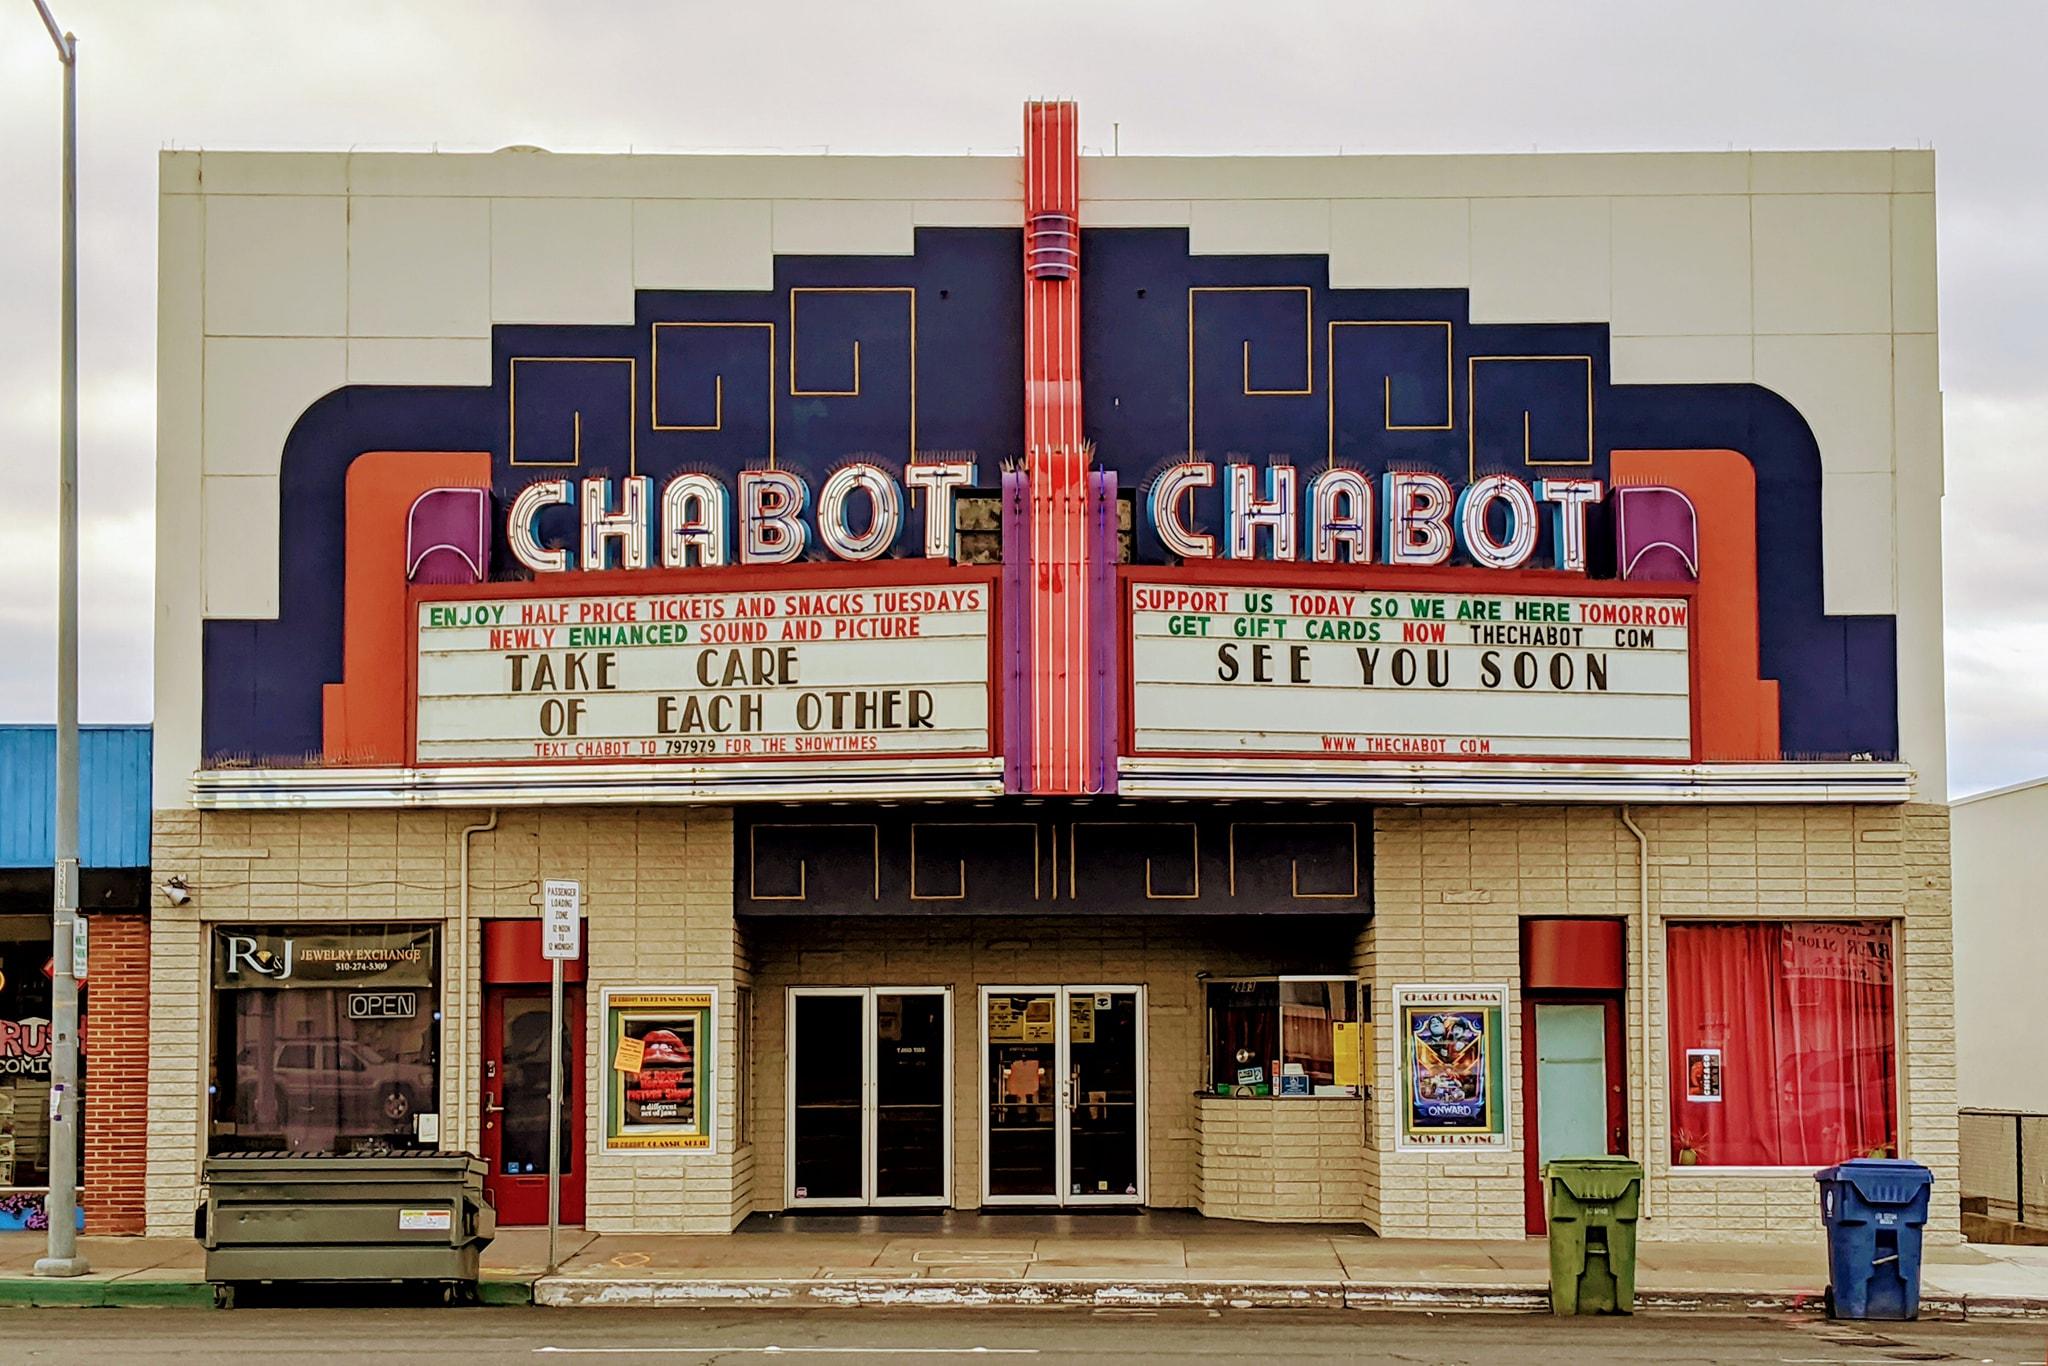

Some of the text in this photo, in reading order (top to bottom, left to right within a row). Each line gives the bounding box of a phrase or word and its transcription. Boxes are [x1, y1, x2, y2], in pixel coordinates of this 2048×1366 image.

[508, 461, 977, 573] CHABOT
[1147, 461, 1602, 572] CHABOT
[431, 589, 980, 626] ENJOY HALF PRICE TICKETS AND SNACKS TUESDAYS
[1135, 590, 1687, 626] SUPPORT US TODAY SO WE ARE HERE TOMORROW
[490, 616, 920, 650] NEWLY ENHANCED SOUND AND PICTURE
[1168, 616, 1654, 647] GET GIFT CARDS NOW THECHABOT COM
[506, 646, 798, 692] TAKE CARE
[1218, 644, 1607, 691] SEE YOU SOON
[541, 689, 934, 736] OF EACH OTHER
[535, 735, 877, 757] TEXT CHABOT TO 797979 FOR THE SHOWTIMES
[1321, 736, 1490, 753] WWW THECHABOT COM
[547, 887, 576, 896] PASSENGER
[551, 899, 572, 907] LOADING
[555, 911, 568, 919] ZONE
[300, 949, 421, 961] JEWELRY EXCHANGE
[352, 996, 413, 1016] OPEN
[1428, 1105, 1472, 1116] ONWARD
